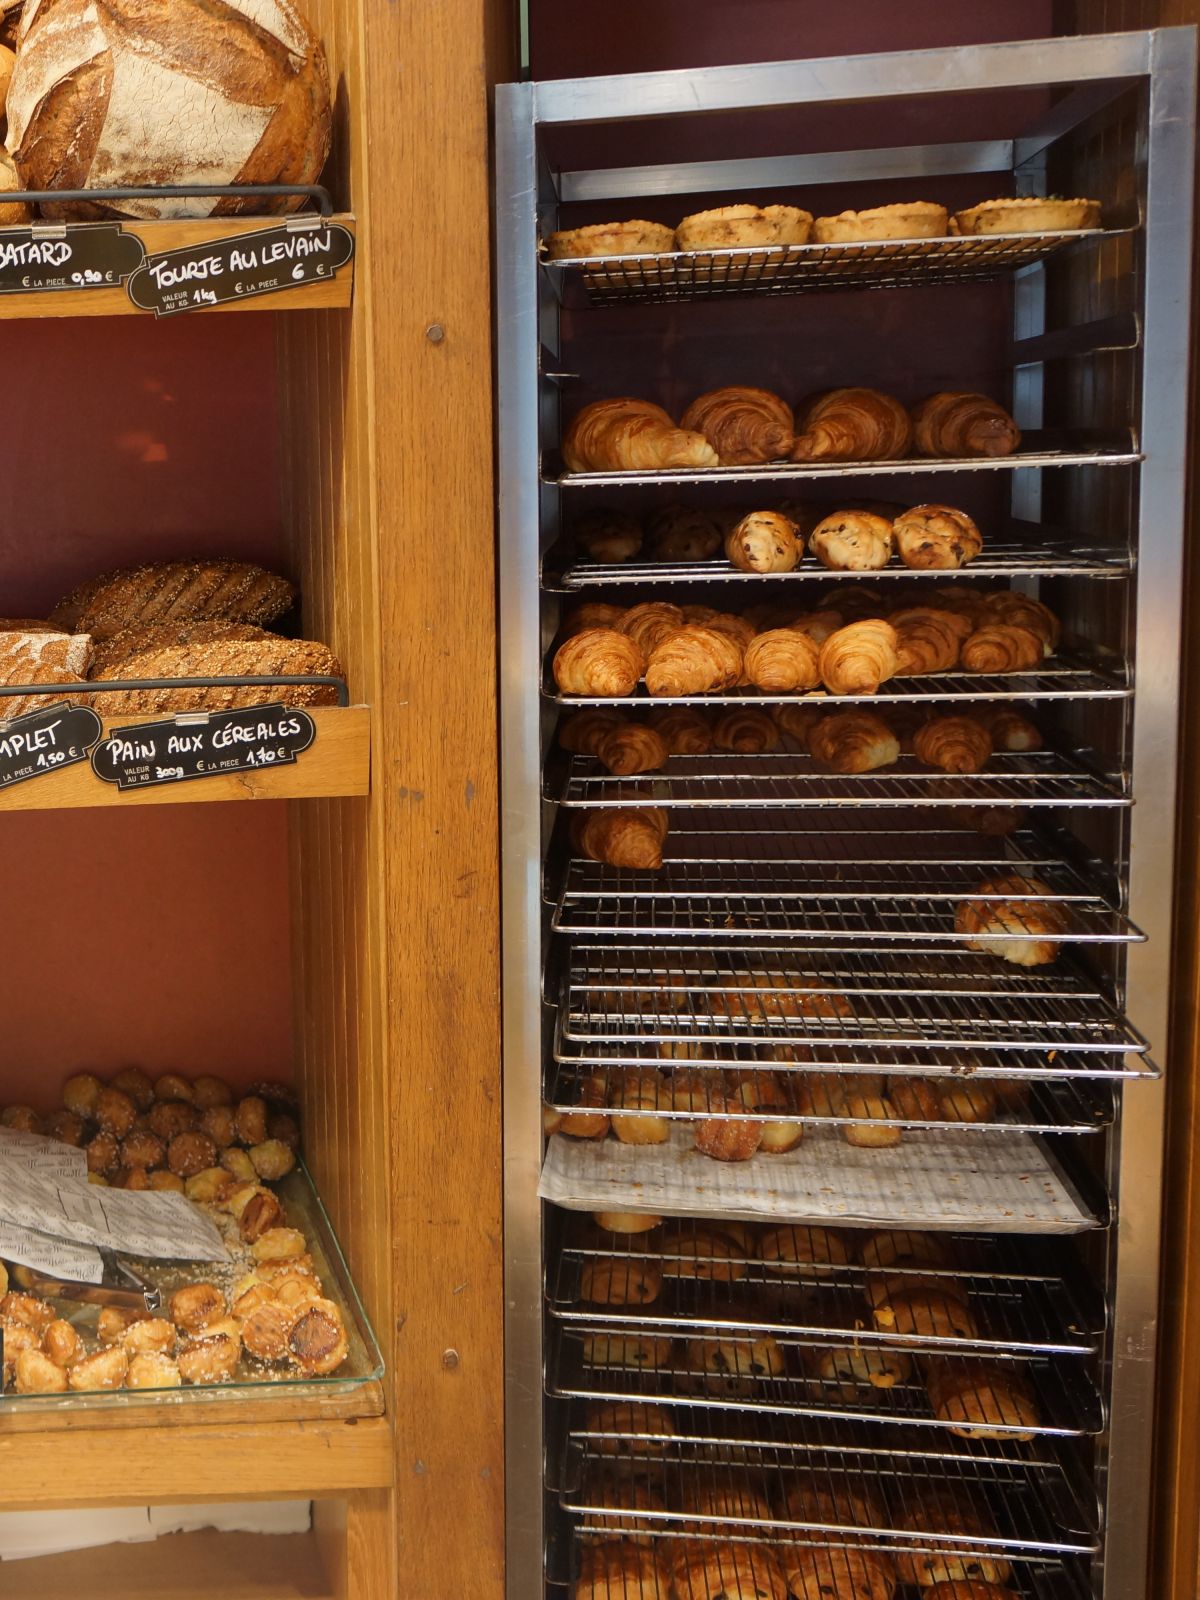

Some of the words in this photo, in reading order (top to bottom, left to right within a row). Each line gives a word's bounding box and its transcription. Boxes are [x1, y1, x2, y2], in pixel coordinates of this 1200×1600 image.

[22, 276, 30, 287] €
[47, 278, 66, 286] PIECE
[71, 269, 102, 286] 0,90
[105, 271, 113, 281] €
[150, 257, 224, 289] TOURTE
[230, 250, 258, 272] AU
[235, 282, 243, 294] €
[258, 279, 279, 289] PIECE
[291, 263, 305, 280] 6
[316, 264, 325, 275] €
[162, 291, 188, 303] VALEUR
[168, 734, 204, 754] AUX
[212, 718, 301, 748] CÉREALES
[3, 774, 12, 782] LA
[14, 766, 34, 778] PIECE
[36, 752, 66, 768] 1,50
[68, 747, 77, 757] €
[124, 766, 150, 775] VALEUR
[197, 760, 205, 771] €
[220, 759, 239, 767] PIECE
[247, 747, 276, 767] 1,70
[277, 748, 286, 758] €
